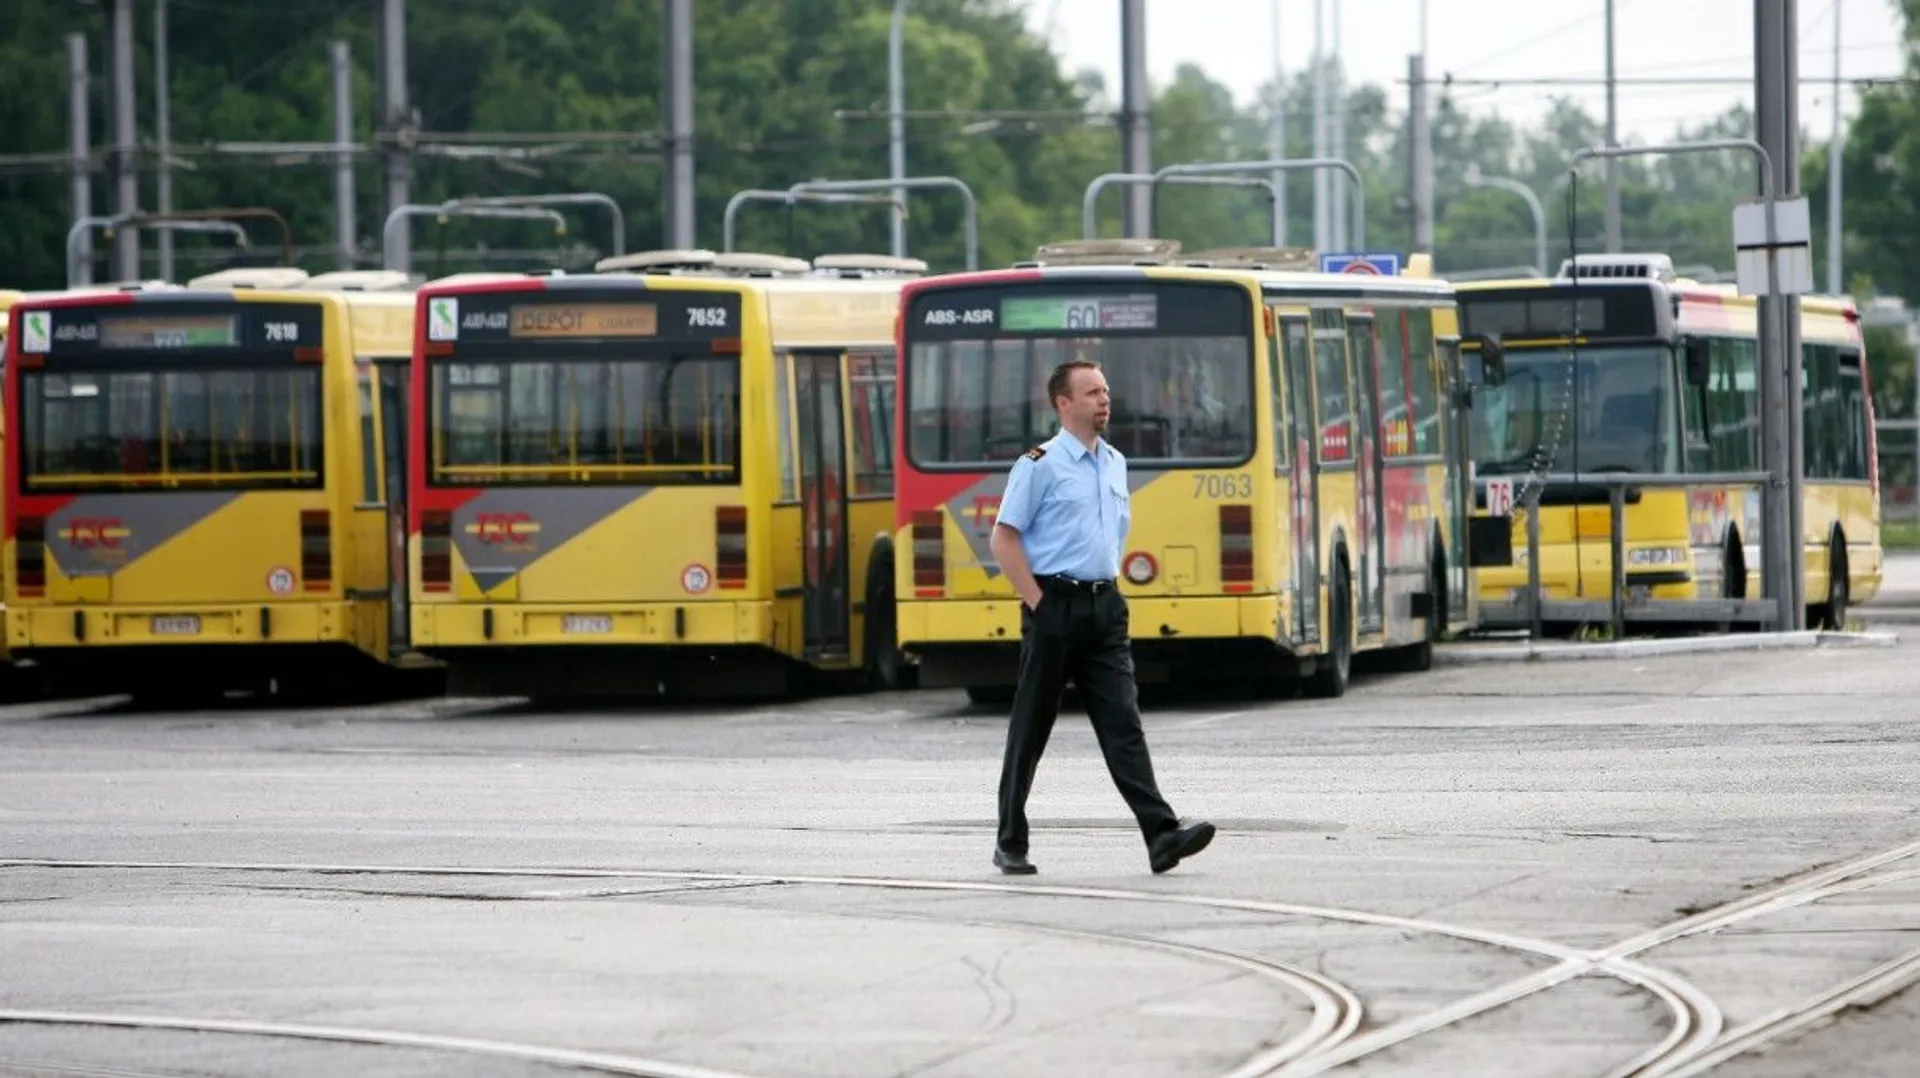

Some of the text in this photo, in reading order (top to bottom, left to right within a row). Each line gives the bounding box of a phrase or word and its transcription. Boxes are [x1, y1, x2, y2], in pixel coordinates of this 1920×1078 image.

[687, 308, 726, 327] 7652
[925, 309, 994, 324] ABS-ASR
[1067, 304, 1098, 330] 60
[1193, 474, 1253, 499] 7063
[1489, 482, 1509, 516] 76
